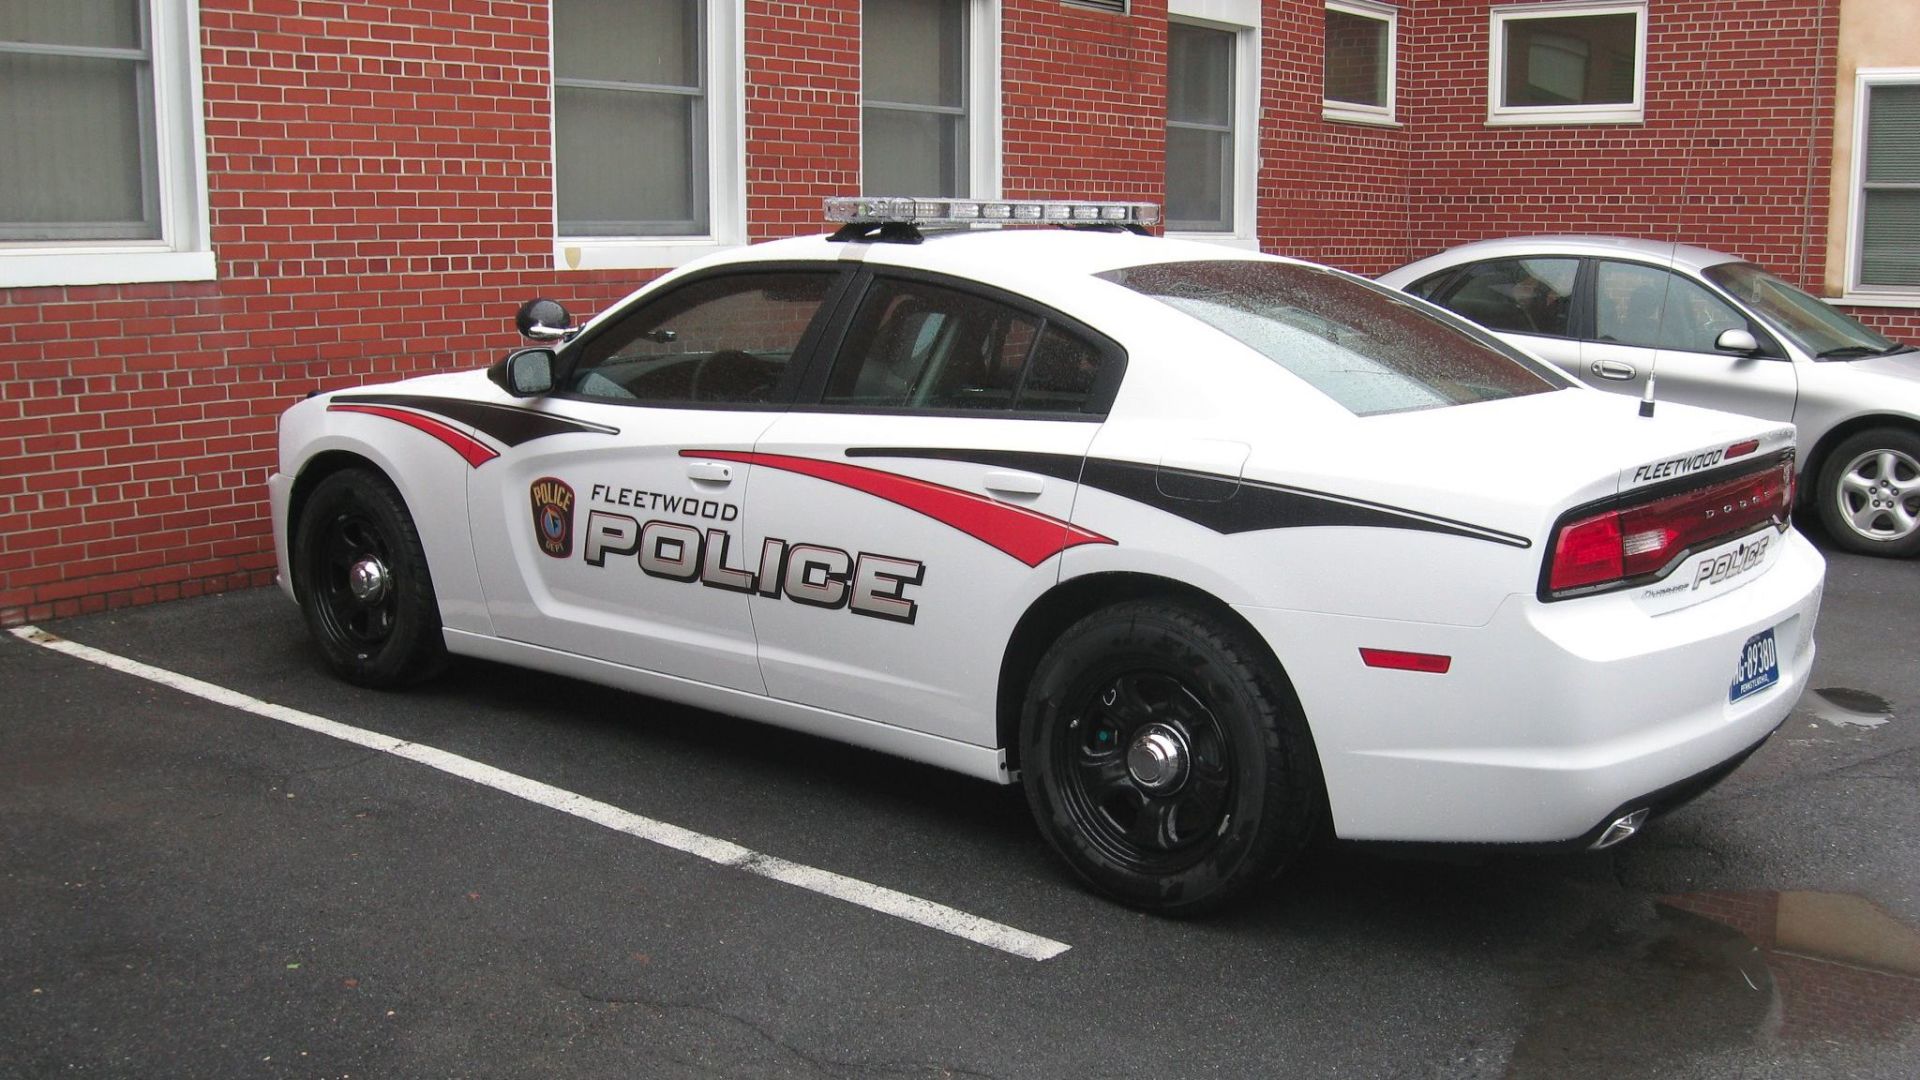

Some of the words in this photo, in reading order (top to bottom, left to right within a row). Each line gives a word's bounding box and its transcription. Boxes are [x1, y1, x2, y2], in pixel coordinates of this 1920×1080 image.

[1633, 449, 1723, 483] FLEETWOOD
[533, 482, 572, 512] POLICE
[591, 484, 739, 522] FLEETWOOD
[584, 510, 926, 625] POLICE
[1692, 536, 1770, 591] POLICE
